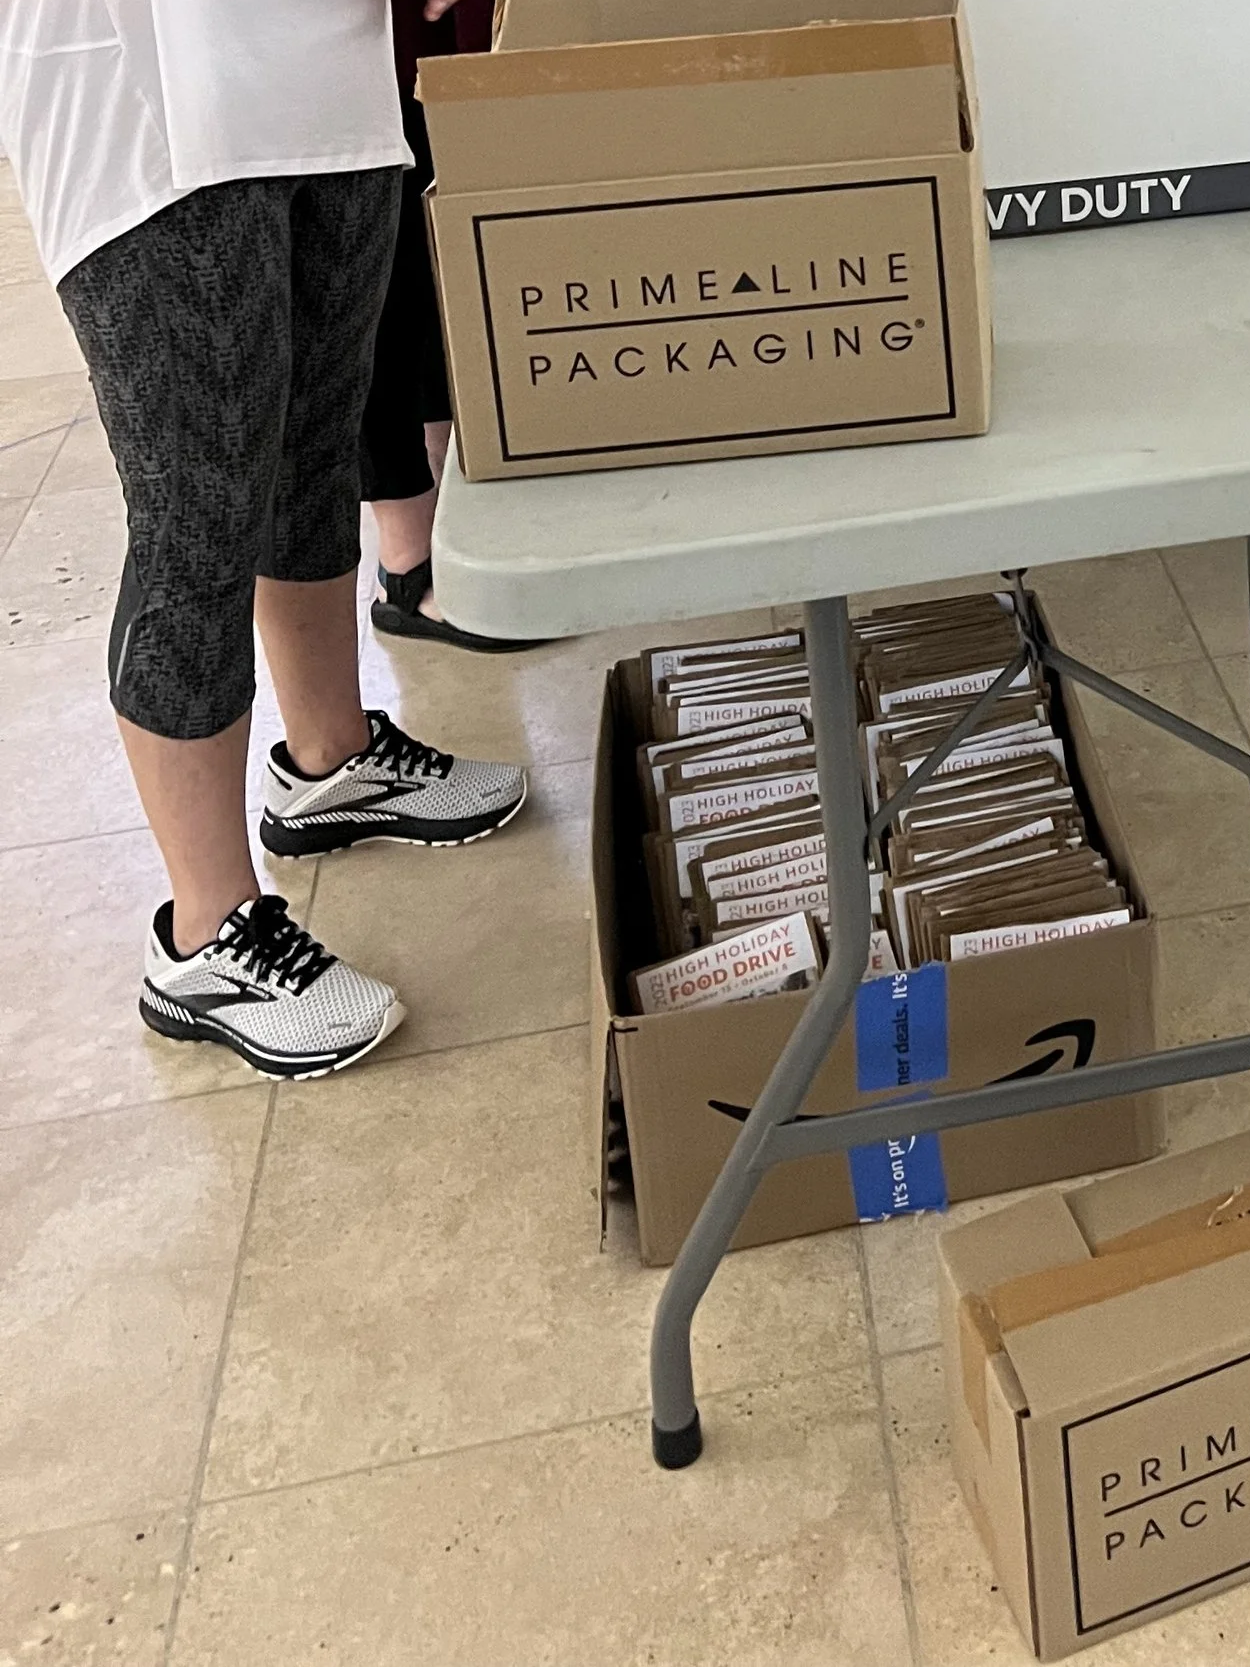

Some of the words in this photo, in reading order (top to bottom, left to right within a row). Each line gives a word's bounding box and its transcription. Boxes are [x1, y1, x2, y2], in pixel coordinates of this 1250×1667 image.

[1061, 175, 1192, 224] DUTY
[521, 270, 719, 317] PRIME
[771, 252, 909, 294] LINE
[950, 677, 996, 694] HOLID
[704, 709, 743, 722] HIGH
[749, 703, 808, 718] HOLIDA
[697, 793, 738, 810] HIGH
[744, 779, 815, 802] HOLIDAY
[731, 852, 772, 871] HIGH
[779, 840, 826, 860] HOLID
[737, 872, 779, 891] HIGH
[786, 858, 824, 879] HOLI
[746, 898, 788, 914] HIGH
[982, 933, 1027, 951] HIGH
[1035, 918, 1116, 943] HOLIDAY
[665, 956, 709, 983] HIGH
[715, 924, 791, 963] HOLIDAY
[669, 969, 728, 1003] FOOD
[733, 941, 798, 977] DRIVE
[892, 972, 908, 999] It's
[893, 1003, 909, 1054] deals.
[891, 1156, 905, 1181] on
[894, 1183, 910, 1209] It's
